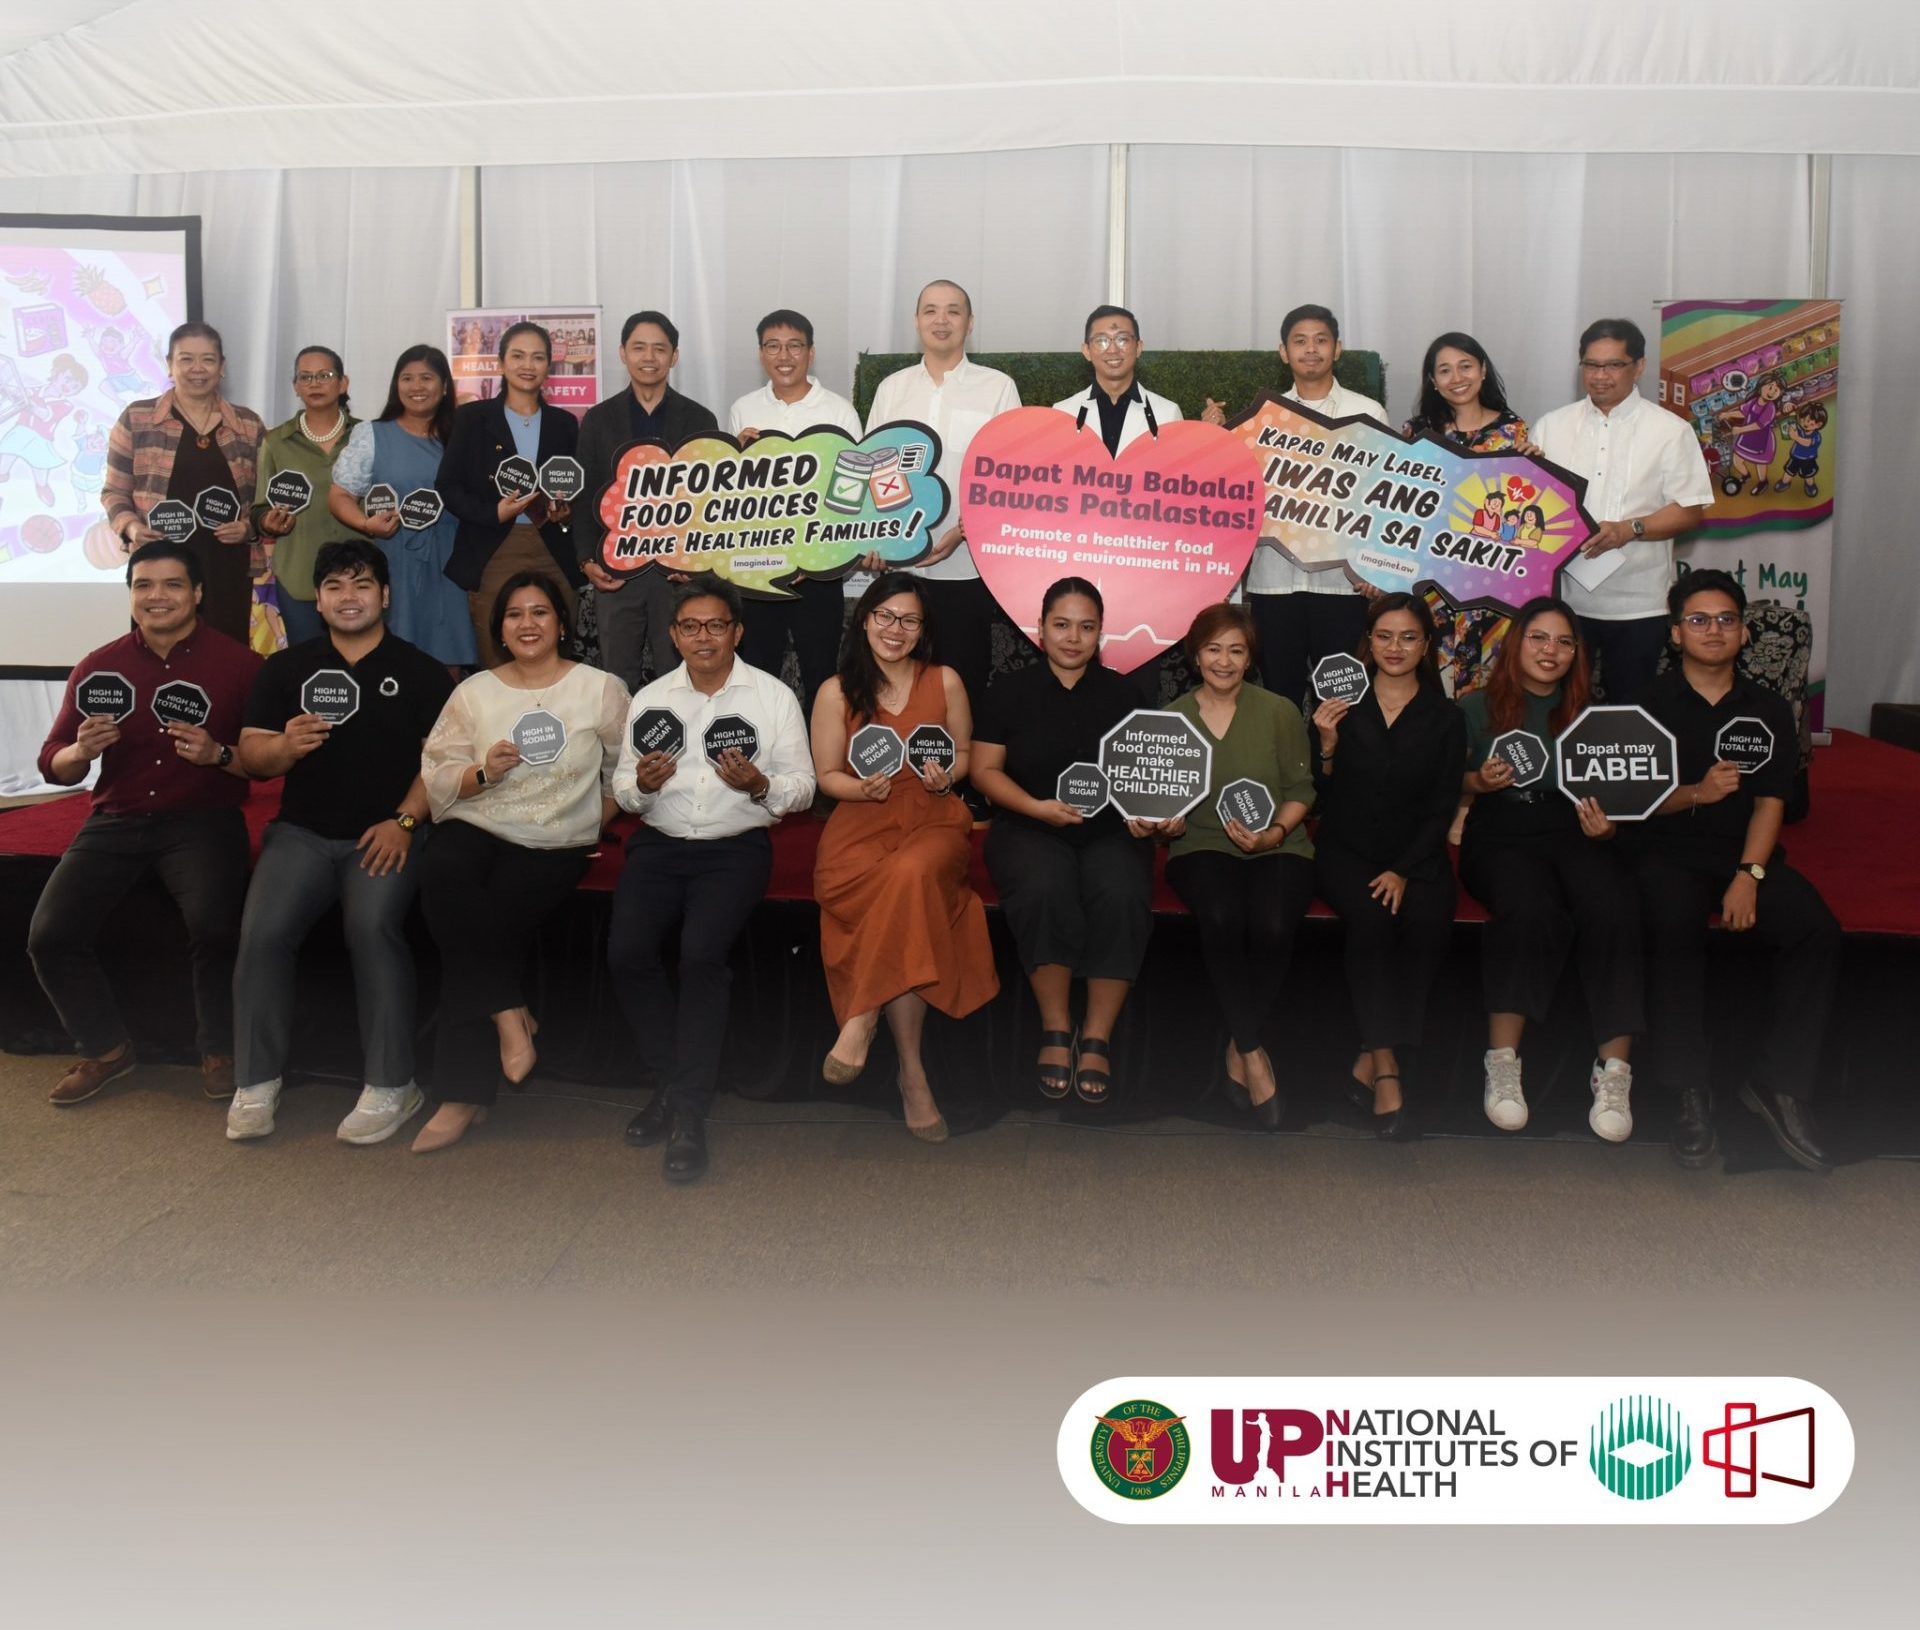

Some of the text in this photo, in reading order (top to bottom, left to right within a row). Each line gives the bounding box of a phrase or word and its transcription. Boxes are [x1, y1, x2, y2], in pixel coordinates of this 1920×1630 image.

[463, 362, 498, 372] HEALT
[1258, 427, 1447, 486] KAPAG MAY LABEL,
[499, 471, 533, 489] TOTAL FATS
[507, 467, 522, 477] HIGH
[627, 454, 818, 499] INFORMED
[974, 456, 1255, 501] Dapat May Babala!
[270, 487, 308, 499] TOTAL FATS
[277, 482, 295, 490] HIGH
[1263, 457, 1440, 518] IWAS ANG
[205, 504, 229, 516] SUGAR
[206, 498, 223, 508] HIGH
[403, 504, 437, 516] TOTAL FATS
[620, 492, 818, 529] FOOD CHOICES
[968, 483, 1255, 531] Bawas Patalastas!
[151, 518, 193, 526] SATURATED
[1001, 523, 1214, 556] Promote a healthier food
[1263, 494, 1526, 576] AMILYA SA SAKIT.
[733, 558, 784, 569] ImagineLaw
[981, 541, 1234, 576] marketing environment in PH.
[1361, 553, 1414, 574] ImagineLaw
[1758, 562, 1808, 598] May
[1317, 672, 1364, 689] SATURATED
[1323, 666, 1354, 679] HIGH IN
[113, 689, 122, 697] IN
[314, 687, 337, 695] HIGH
[1333, 683, 1353, 693] FATS
[87, 697, 124, 705] SODIUM
[166, 694, 199, 709] HIGH IN
[312, 695, 348, 704] SODIUM
[157, 698, 183, 711] TOTAL
[184, 706, 204, 718] FATS
[522, 725, 554, 737] HIGH IN
[641, 717, 668, 744] HIGH IN
[648, 724, 672, 749] SUGAR
[713, 729, 746, 740] HIGH IN
[1125, 729, 1187, 745] Informed
[522, 733, 556, 746] SODIUM
[706, 736, 755, 749] SATURATED
[1729, 735, 1751, 743] HIGH
[859, 736, 888, 760] HIGH IN
[865, 744, 891, 766] SUGAR
[1112, 741, 1201, 758] food choices
[1514, 740, 1534, 771] HIGH IN
[1576, 743, 1656, 757] Dapat may
[1720, 743, 1769, 754] TOTAL FATS
[1136, 756, 1174, 767] make
[1506, 743, 1527, 775] SODIUM
[1107, 765, 1200, 784] HEALTHIER
[1565, 756, 1670, 782] LABEL
[1068, 779, 1099, 789] HIGH IN
[1069, 787, 1097, 797] SUGAR
[1113, 780, 1193, 797] CHILDREN.
[1233, 792, 1253, 825] SODIUM
[1241, 789, 1261, 820] HIGH IN
